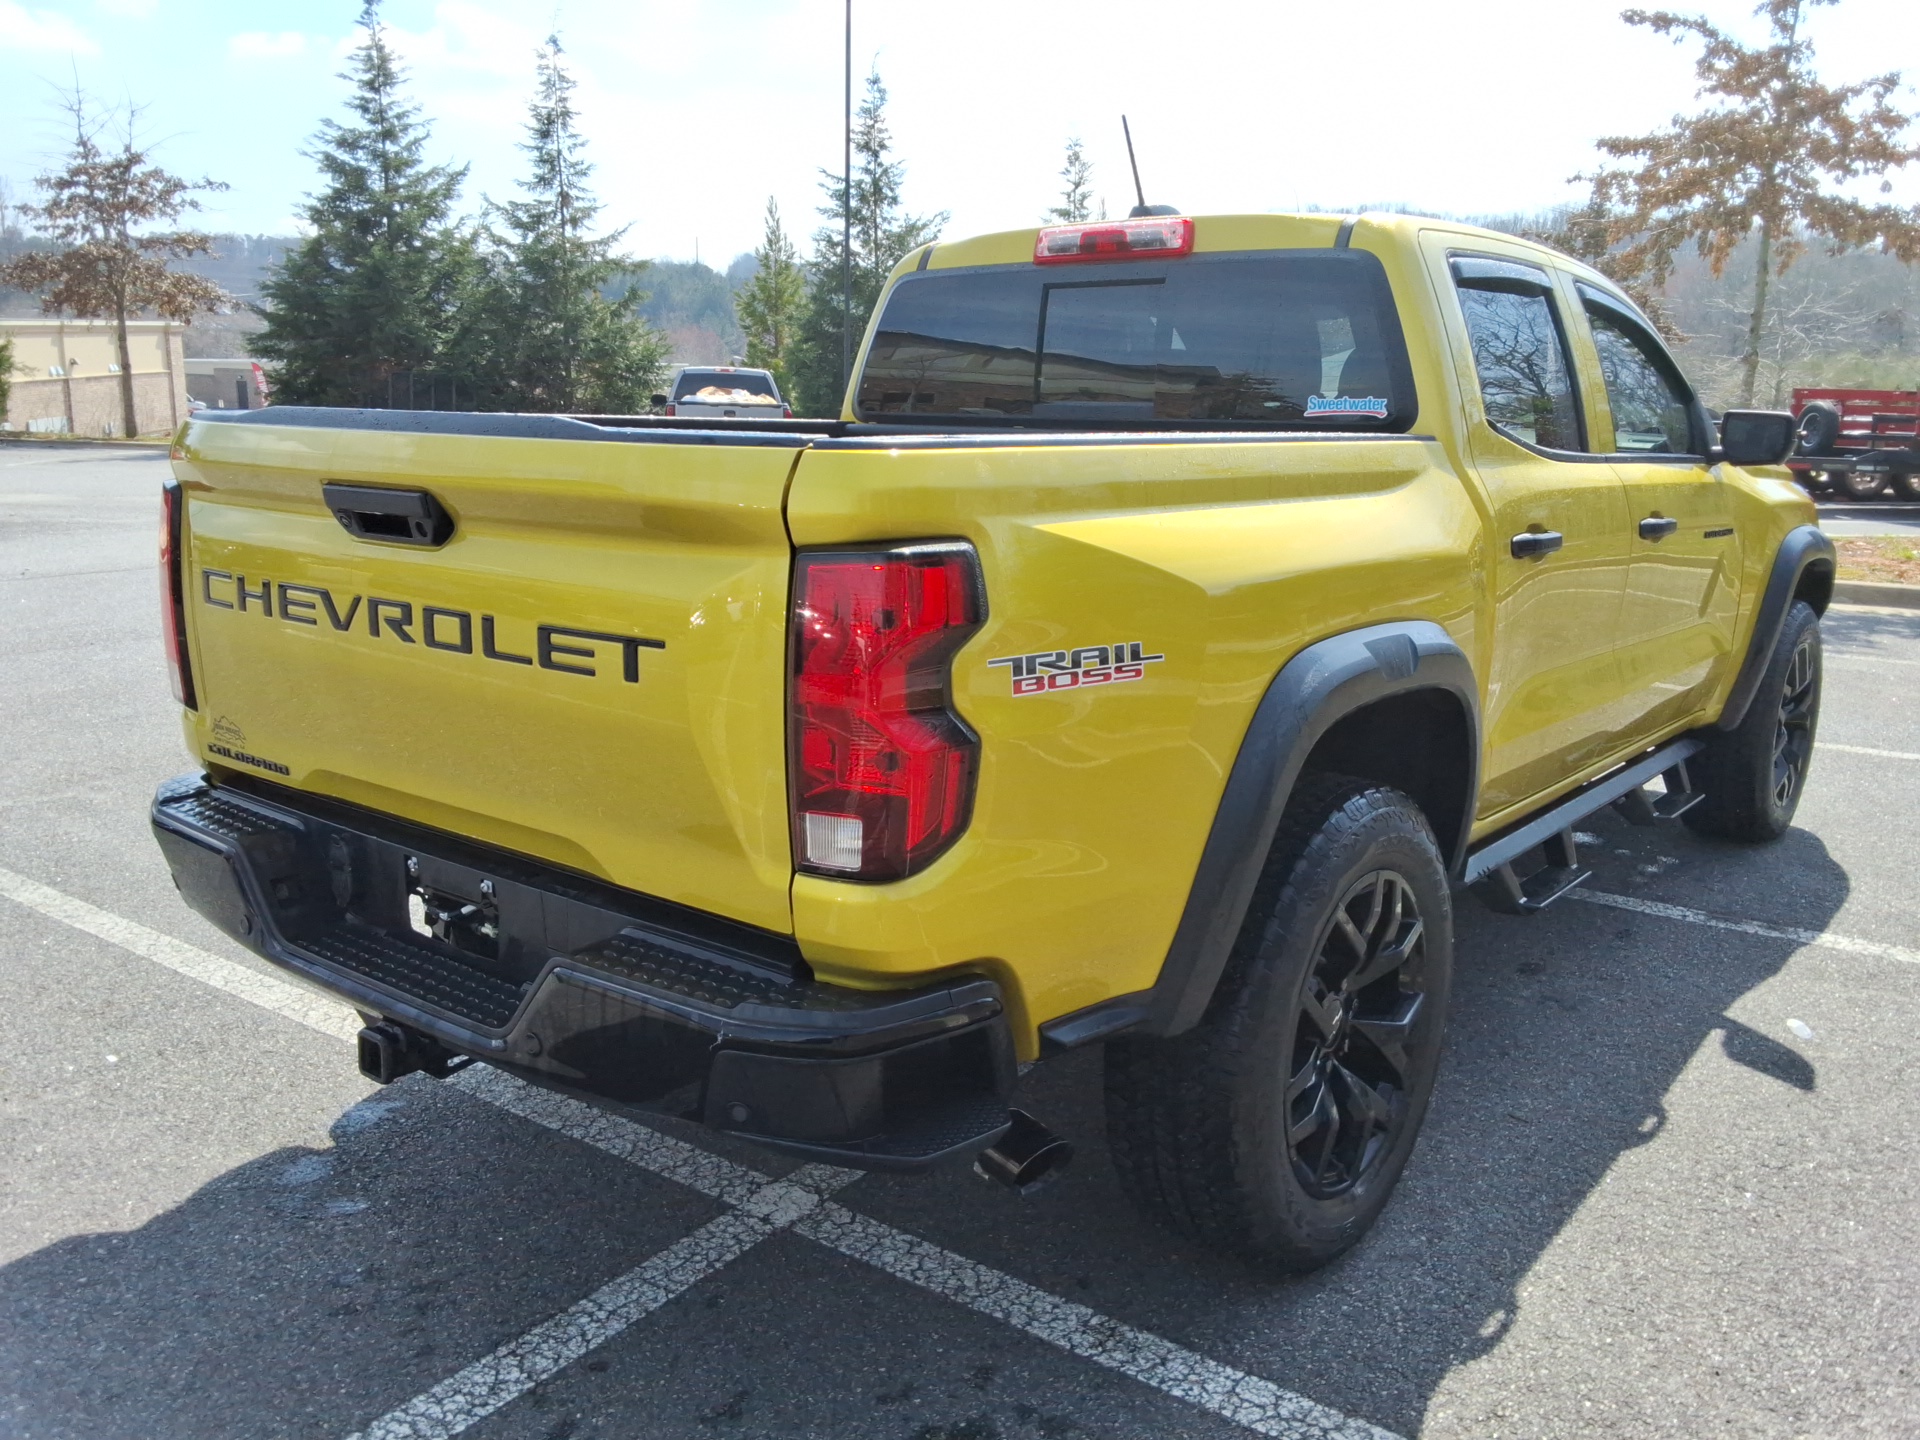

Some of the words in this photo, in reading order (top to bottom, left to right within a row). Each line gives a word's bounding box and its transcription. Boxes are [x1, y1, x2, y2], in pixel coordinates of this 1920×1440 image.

[1307, 396, 1387, 411] Sweetwater
[201, 567, 666, 684] CHEVROLET
[987, 641, 1164, 678] TRAIL
[1012, 662, 1143, 697] BOSS
[207, 743, 290, 776] COLORADO
